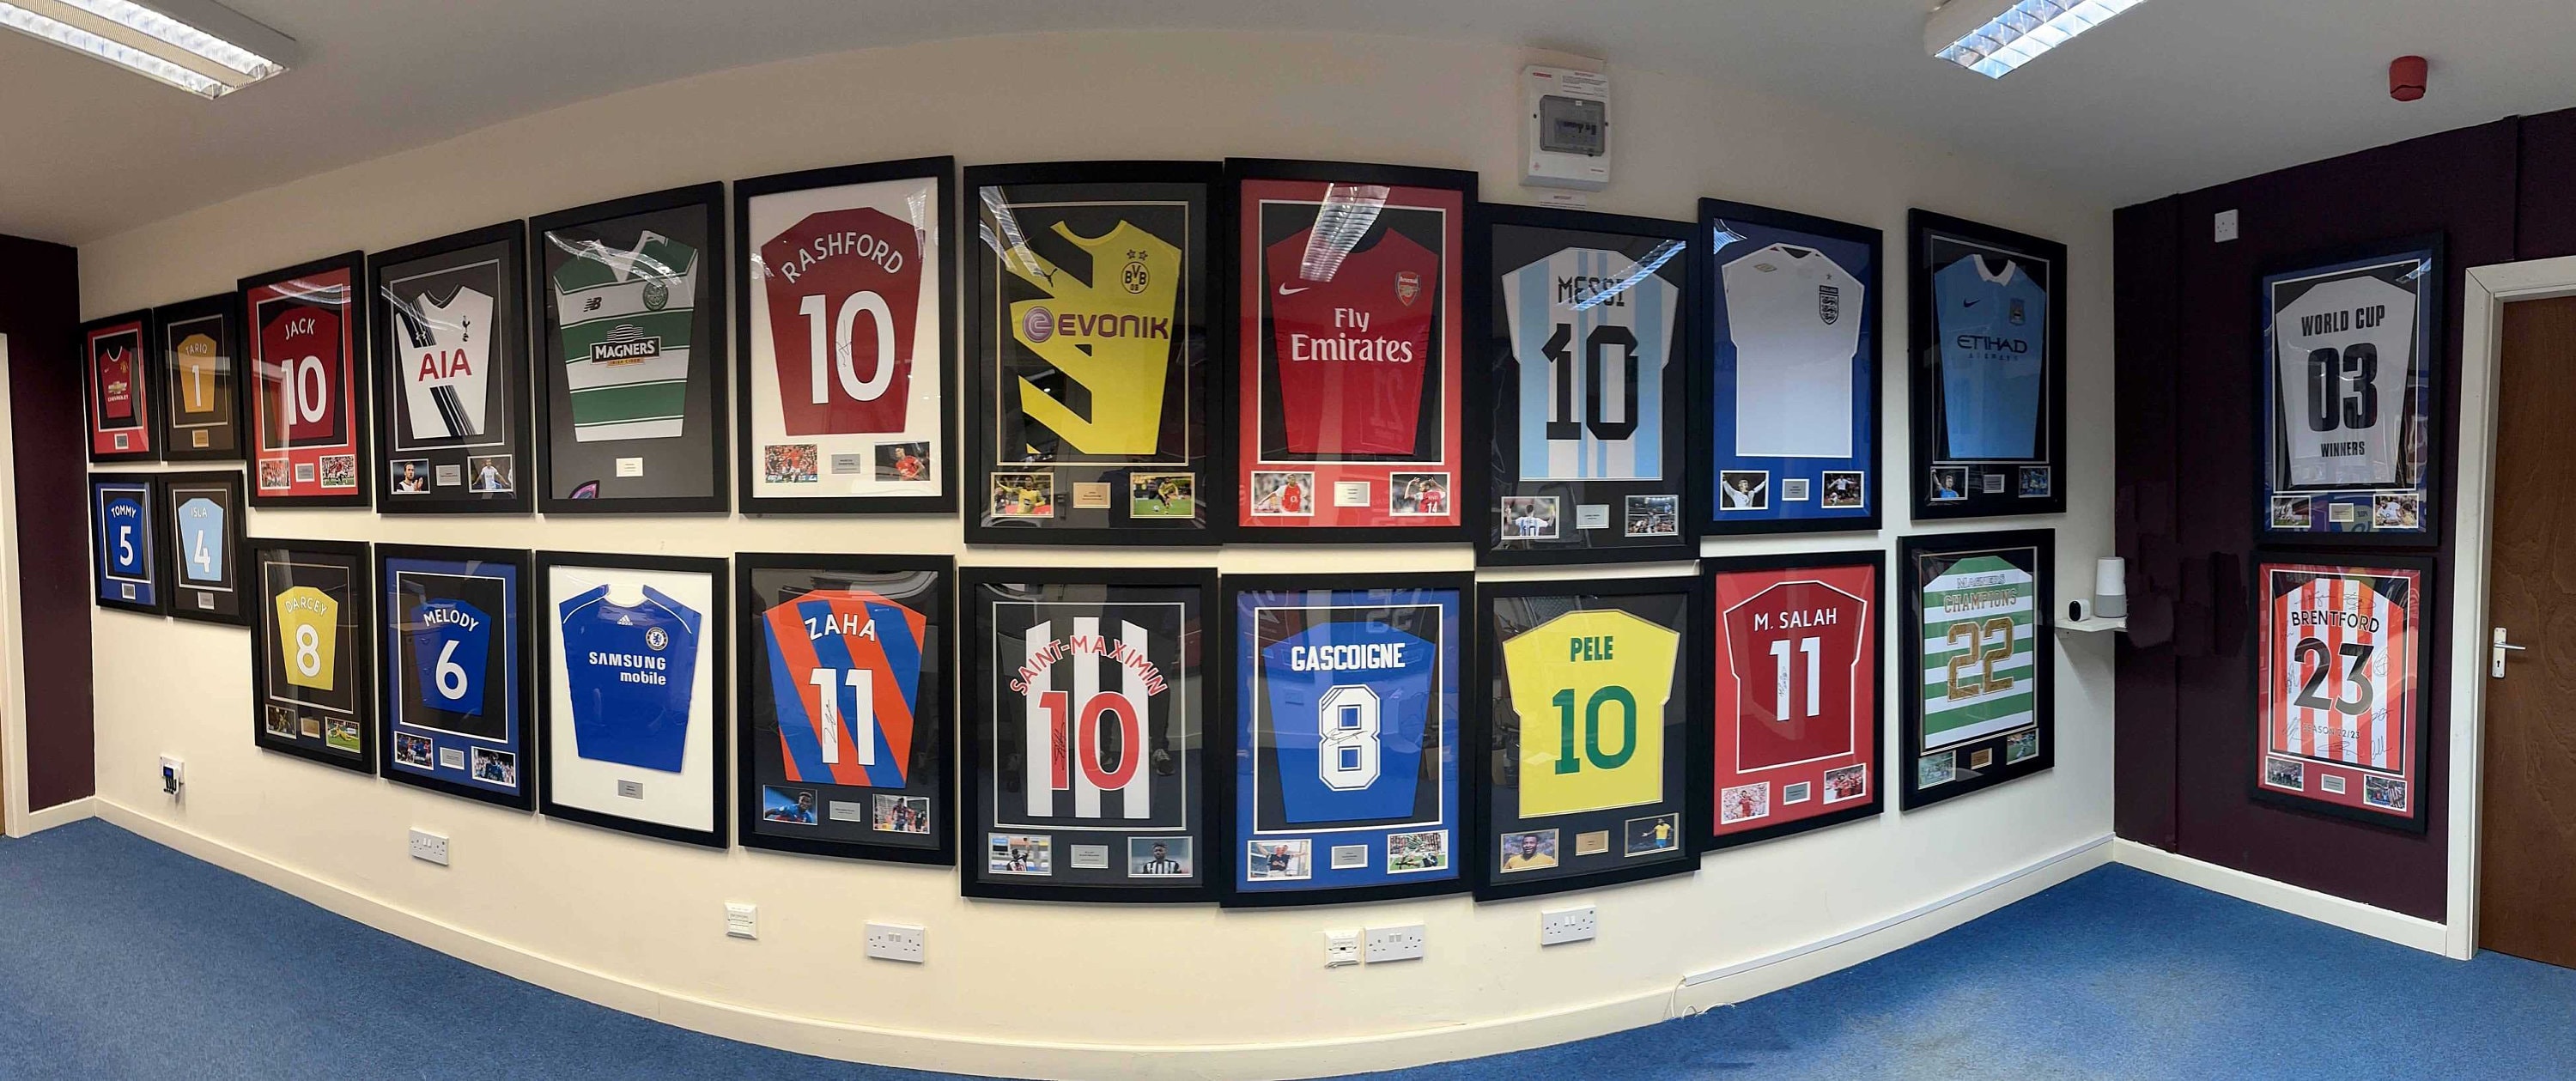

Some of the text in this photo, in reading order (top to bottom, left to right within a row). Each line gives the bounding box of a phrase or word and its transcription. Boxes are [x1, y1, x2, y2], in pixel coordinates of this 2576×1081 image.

[781, 231, 903, 285] RASHFORD
[1558, 275, 1625, 307] MESSI
[285, 318, 315, 340] JACK
[1057, 313, 1169, 340] EVONIK
[1334, 307, 1370, 333] Fly
[2301, 304, 2385, 336] WORLD CUP
[185, 343, 208, 355] TARIQ
[594, 339, 656, 360] MAGNERS
[799, 290, 896, 405] 10
[1291, 332, 1413, 363] Emirates
[1956, 335, 2028, 354] ETIHAD
[418, 348, 471, 382] AIA
[191, 364, 202, 408] 1
[281, 355, 327, 426] 10
[1541, 323, 1638, 441] 10
[2307, 342, 2378, 433] 03
[2320, 440, 2366, 459] WINNERS
[111, 505, 137, 519] TOMMY
[190, 507, 208, 519] ISLA
[119, 525, 134, 568] 5
[194, 529, 210, 574] 4
[285, 598, 328, 617] DARCEY
[1943, 588, 2018, 613] CHAMPIONS
[422, 608, 480, 633] MELODY
[805, 613, 877, 641] ZAHA
[1754, 608, 1837, 632] M. SALAH
[2291, 610, 2380, 634] BRENTFORD
[295, 623, 322, 677] 8
[588, 651, 666, 671] SAMSUNG
[1291, 642, 1406, 671] GASCOIGNE
[1570, 635, 1613, 662] PELE
[1947, 616, 2015, 702] 22
[434, 640, 468, 701] 6
[620, 670, 666, 686] mobile
[1009, 634, 1168, 696] SAINT-MAXIMIN
[1770, 636, 1821, 722] 11
[2293, 636, 2375, 717] 23
[810, 667, 875, 766] 11
[1552, 684, 1637, 775] 10
[2303, 722, 2360, 739] SEASON 22/23
[1038, 690, 1141, 791] 10
[1318, 683, 1381, 792] 8
